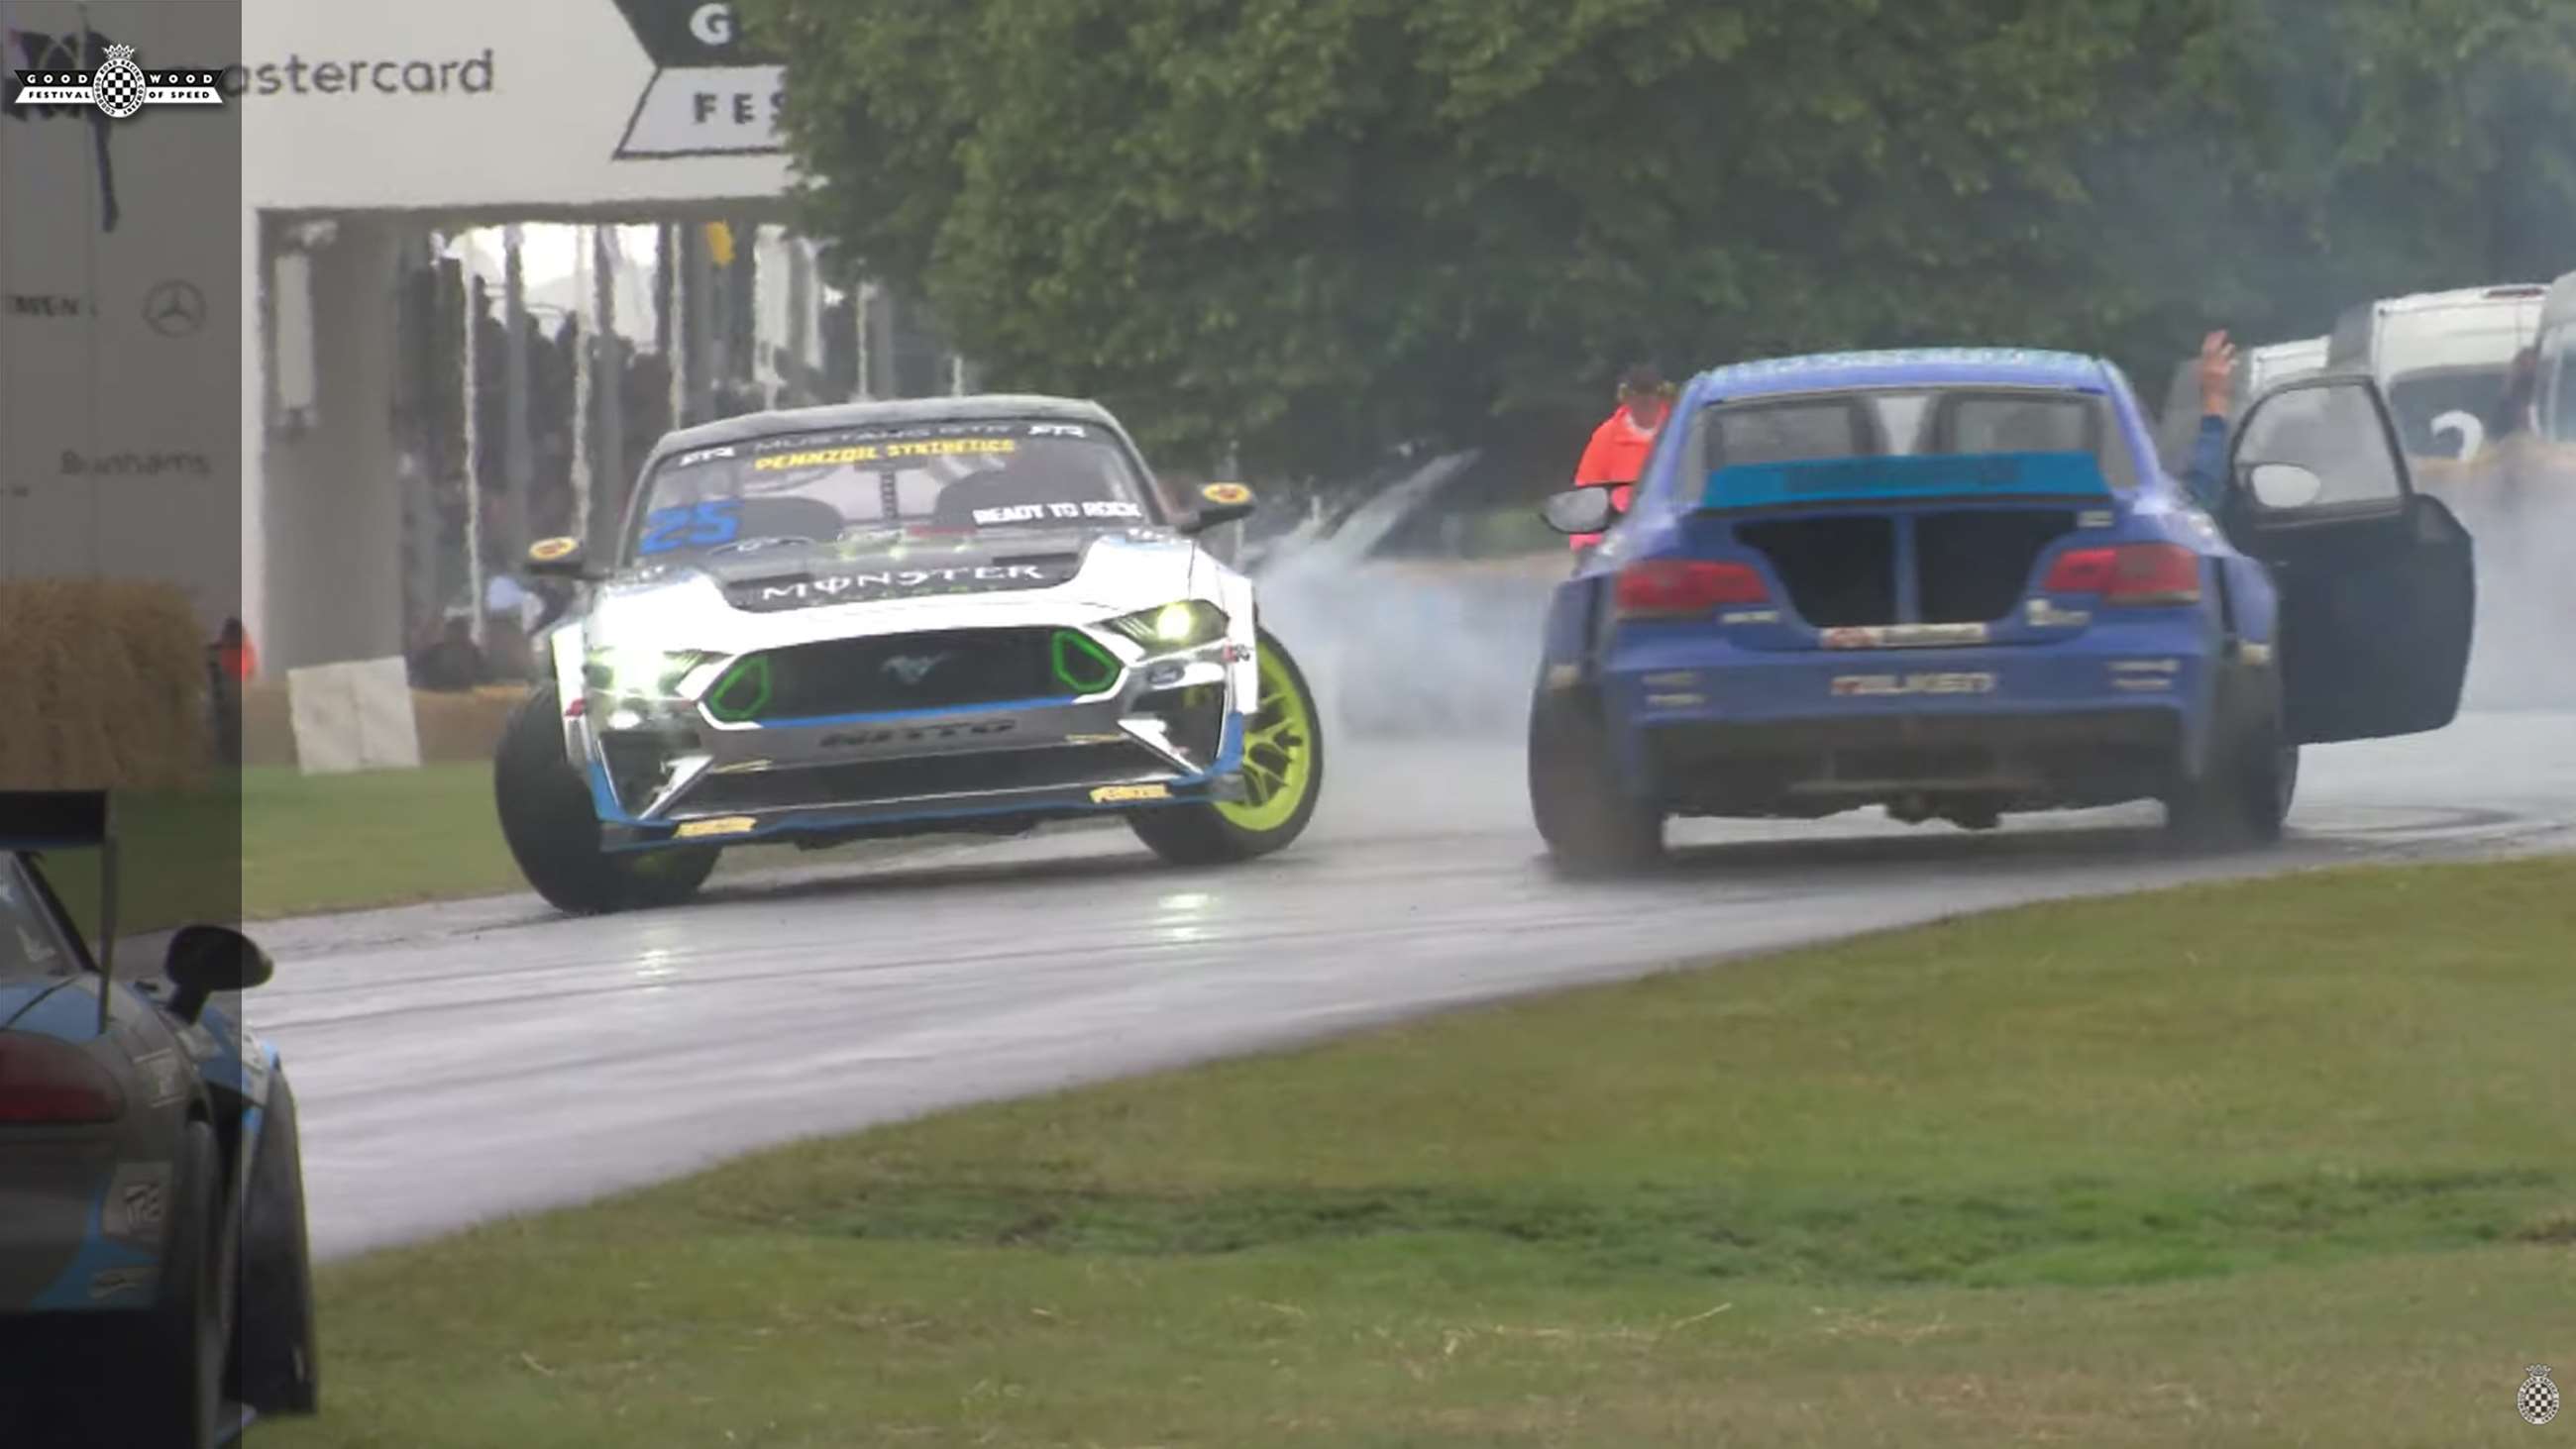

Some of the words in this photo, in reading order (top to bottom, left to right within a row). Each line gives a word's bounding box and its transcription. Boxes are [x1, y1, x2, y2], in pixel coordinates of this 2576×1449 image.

[754, 445, 879, 470] PENNZOIL
[972, 503, 1043, 525] READY
[1046, 502, 1078, 518] TO
[1082, 501, 1142, 518] ROCK
[639, 501, 745, 554] 25
